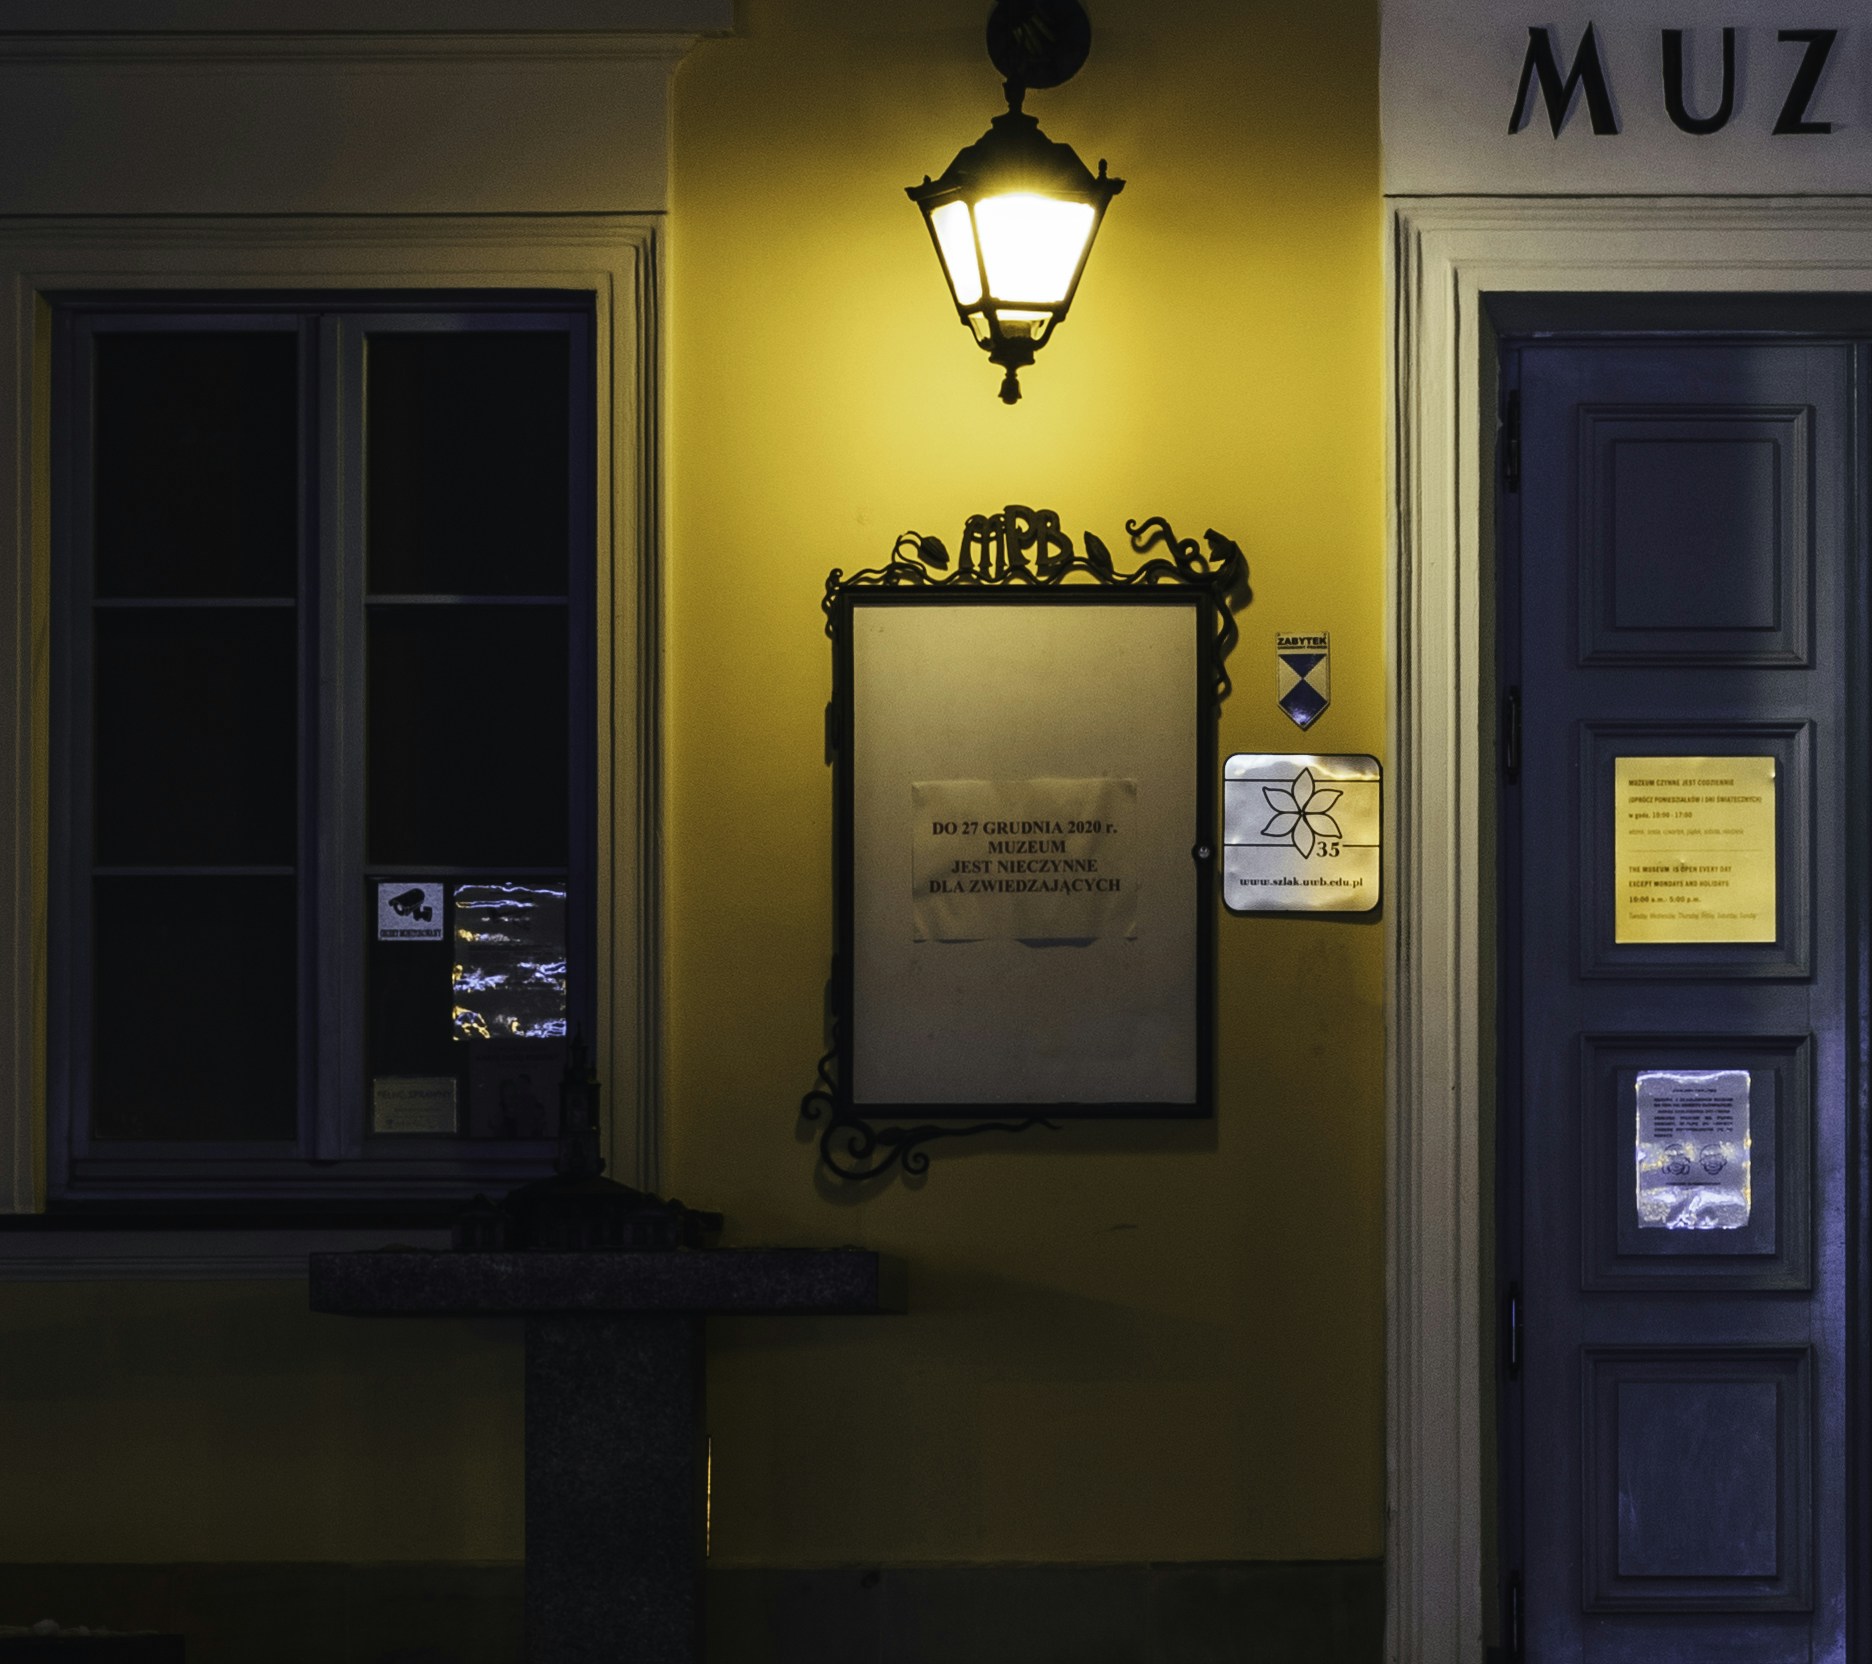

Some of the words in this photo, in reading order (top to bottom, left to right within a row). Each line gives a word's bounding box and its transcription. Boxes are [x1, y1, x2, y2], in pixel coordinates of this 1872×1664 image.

[1277, 636, 1327, 646] ZABYTEK
[931, 821, 957, 835] DO
[961, 821, 978, 835] 27
[983, 821, 1063, 835] GRUDNIA
[1067, 820, 1102, 834] 2020
[1106, 822, 1118, 834] r.
[988, 840, 1066, 854] MUZEUM
[1316, 841, 1340, 857] 35
[951, 860, 992, 874] JEST
[997, 859, 1098, 874] NIECZYNNE
[929, 879, 966, 893] DLA
[969, 877, 1121, 895] ZWIEDZAJĄCYCH
[1240, 877, 1363, 888] www.szlak.uwb.edu.pl
